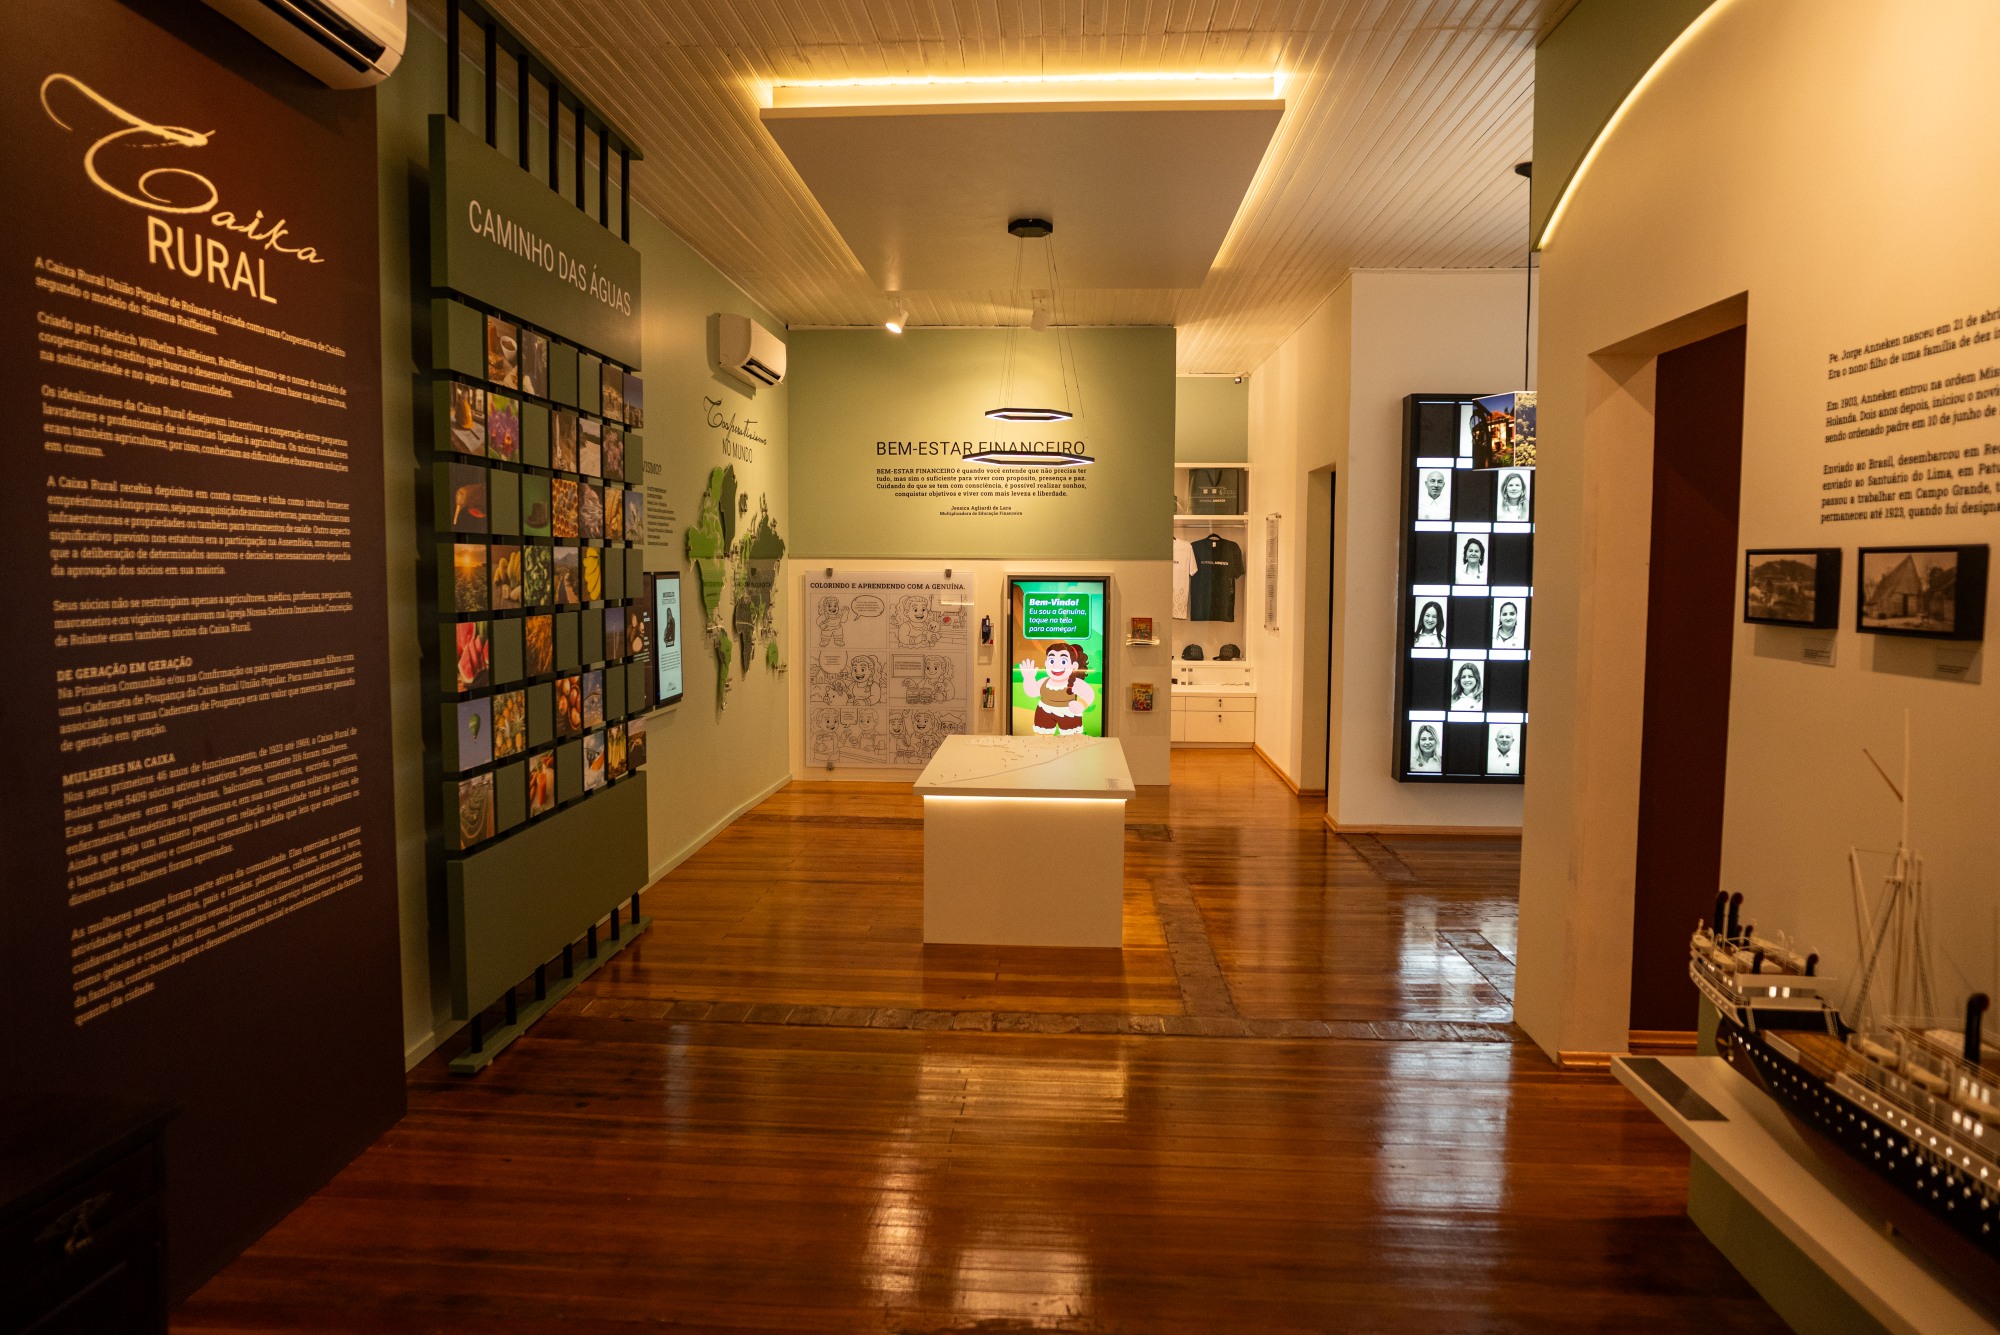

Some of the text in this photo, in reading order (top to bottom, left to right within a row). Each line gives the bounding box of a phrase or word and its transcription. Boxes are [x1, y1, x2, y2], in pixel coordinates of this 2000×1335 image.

[147, 215, 278, 304] RURAL
[469, 200, 630, 316] CAMINHO DAS ÁGUAS
[1829, 310, 2000, 363] Pe. Jorge Anneken nasceu em 21 de abri
[1828, 369, 1840, 379] Era
[1848, 363, 1867, 374] nono
[1869, 357, 1887, 369] filho
[1890, 353, 1899, 364] de
[1902, 350, 1920, 361] uma
[1923, 340, 1956, 356] família
[1959, 335, 1970, 347] de
[1974, 332, 1990, 343] dez
[1826, 373, 1976, 411] Em 1903, Anneken entrou na ordem
[1826, 387, 2000, 426] Holanda. Dois anos depois, iniciou o novi
[1825, 406, 1996, 443] sendo ordenado padre em 10 de junho de
[722, 438, 753, 464] NO MUNDO
[876, 441, 1085, 456] BEM-ESTAR FINANCEIRO
[1823, 448, 1979, 474] Enviado ao Brasil, desembarcou em
[1822, 478, 1852, 490] enviado
[1868, 474, 1908, 485] Santuário
[1912, 470, 1923, 481] do
[1927, 469, 1952, 480] Lima,
[1958, 467, 1973, 476] em
[1978, 463, 2000, 474] Patu
[1821, 497, 1847, 508] passou
[1857, 491, 1895, 503] trabalhar
[1898, 491, 1912, 499] em
[1916, 488, 1948, 499] Campo
[1952, 482, 1991, 495] Grande,
[1821, 502, 2000, 524] permaneceu até 1923, quando foi designa
[57, 656, 192, 681] DE GERAÇÃO EM GERAÇÃO
[62, 753, 175, 785] MULHERES NA CAIXA
